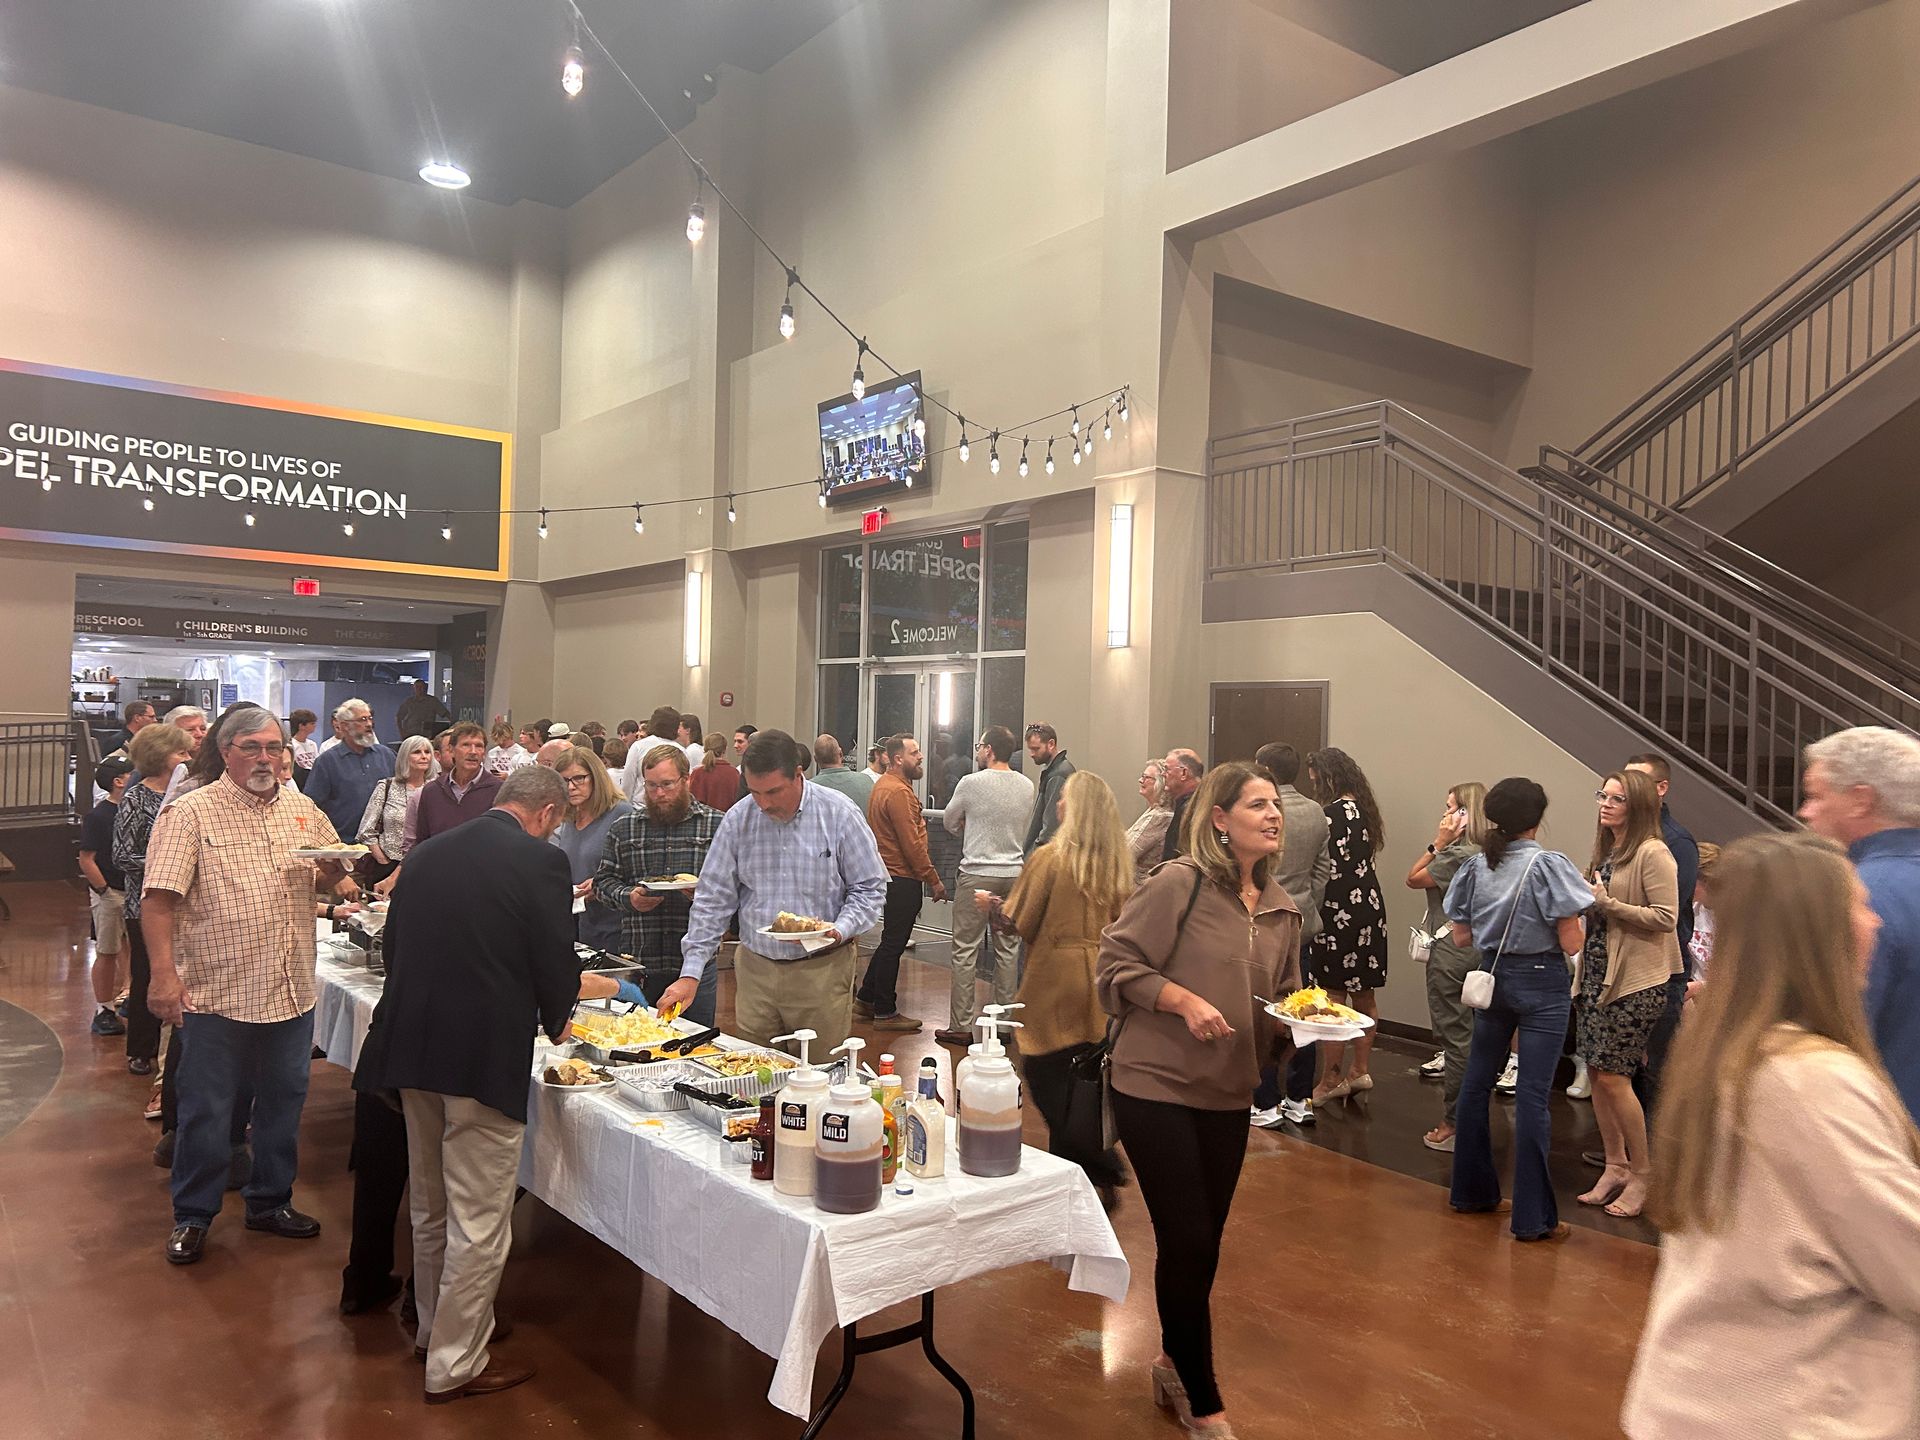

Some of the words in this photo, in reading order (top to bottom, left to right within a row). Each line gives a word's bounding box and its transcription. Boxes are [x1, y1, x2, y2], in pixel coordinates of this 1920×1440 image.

[8, 422, 119, 453] GUIDING
[125, 437, 212, 464] PEOPLE
[216, 448, 246, 468] TO
[251, 453, 308, 475] LIVES
[311, 461, 341, 478] OF
[67, 454, 406, 519] TRANSFORMATION
[75, 614, 144, 627] RESCHOOL
[183, 621, 252, 634] CHILDREN'S
[255, 625, 308, 637] BUILDING
[781, 1114, 805, 1128] WHITE
[823, 1126, 847, 1140] MILD
[752, 1150, 764, 1161] OT
